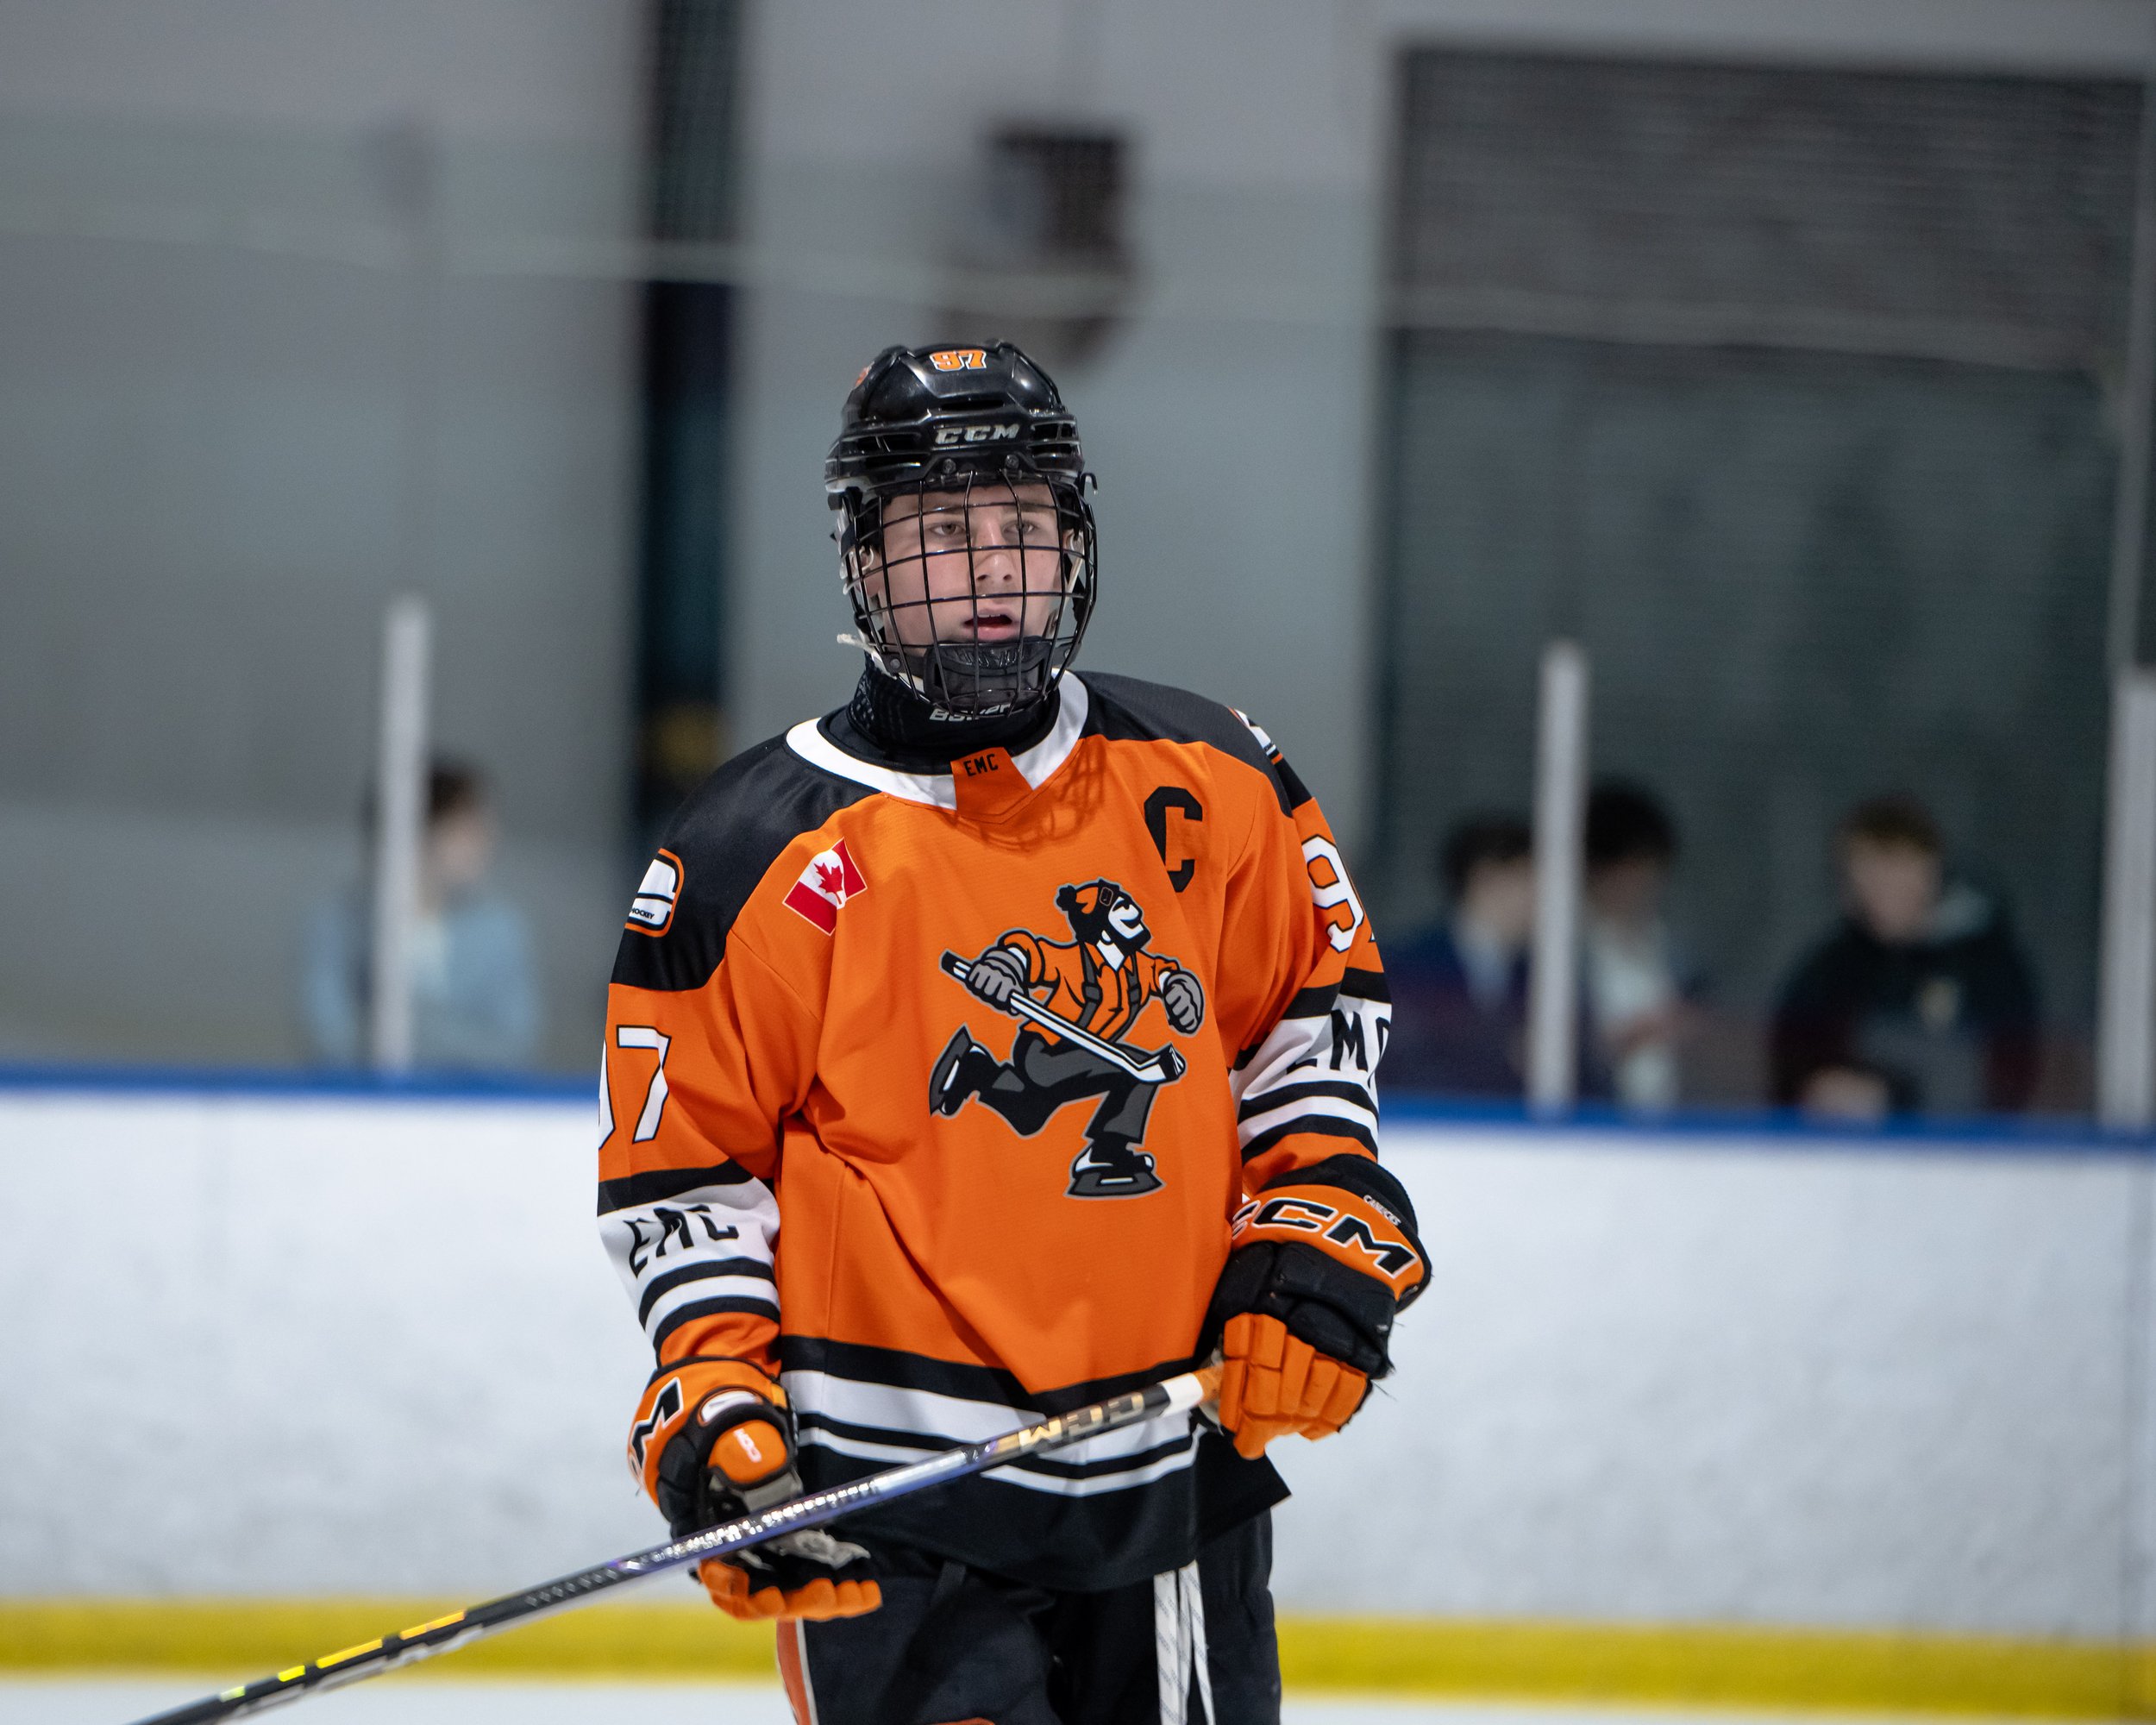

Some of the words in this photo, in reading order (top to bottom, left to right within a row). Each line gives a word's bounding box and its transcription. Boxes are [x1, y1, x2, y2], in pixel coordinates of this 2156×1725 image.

[930, 348, 987, 371] 97
[935, 423, 1020, 444] CCM
[963, 753, 999, 777] EMC
[1144, 786, 1203, 894] C
[1300, 833, 1376, 954] 9
[1018, 1390, 1145, 1453] CCM
